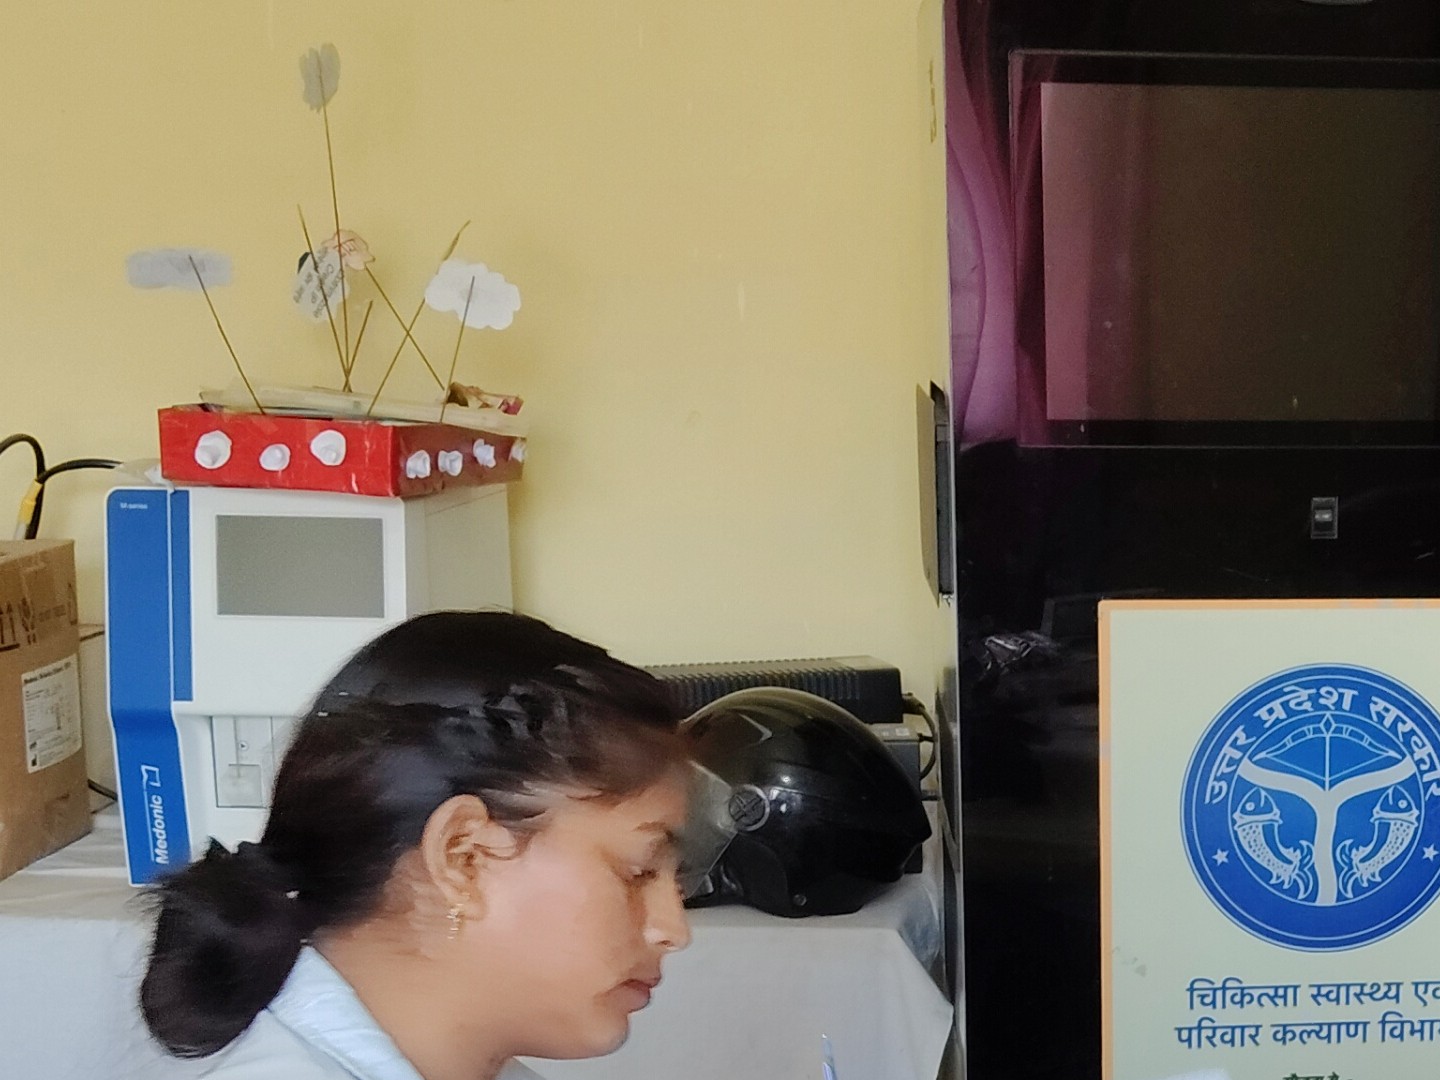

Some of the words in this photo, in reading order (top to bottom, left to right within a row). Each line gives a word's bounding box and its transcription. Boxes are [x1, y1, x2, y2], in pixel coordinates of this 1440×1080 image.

[1205, 725, 1257, 805] उत्तर
[1253, 685, 1358, 729] प्रदेश
[150, 795, 169, 864] Medonic
[1186, 977, 1301, 1011] चिकित्सा
[1309, 981, 1403, 1007] स्वास्थ्य
[1175, 1017, 1262, 1049] परिवार
[1271, 1018, 1370, 1046] कल्याण
